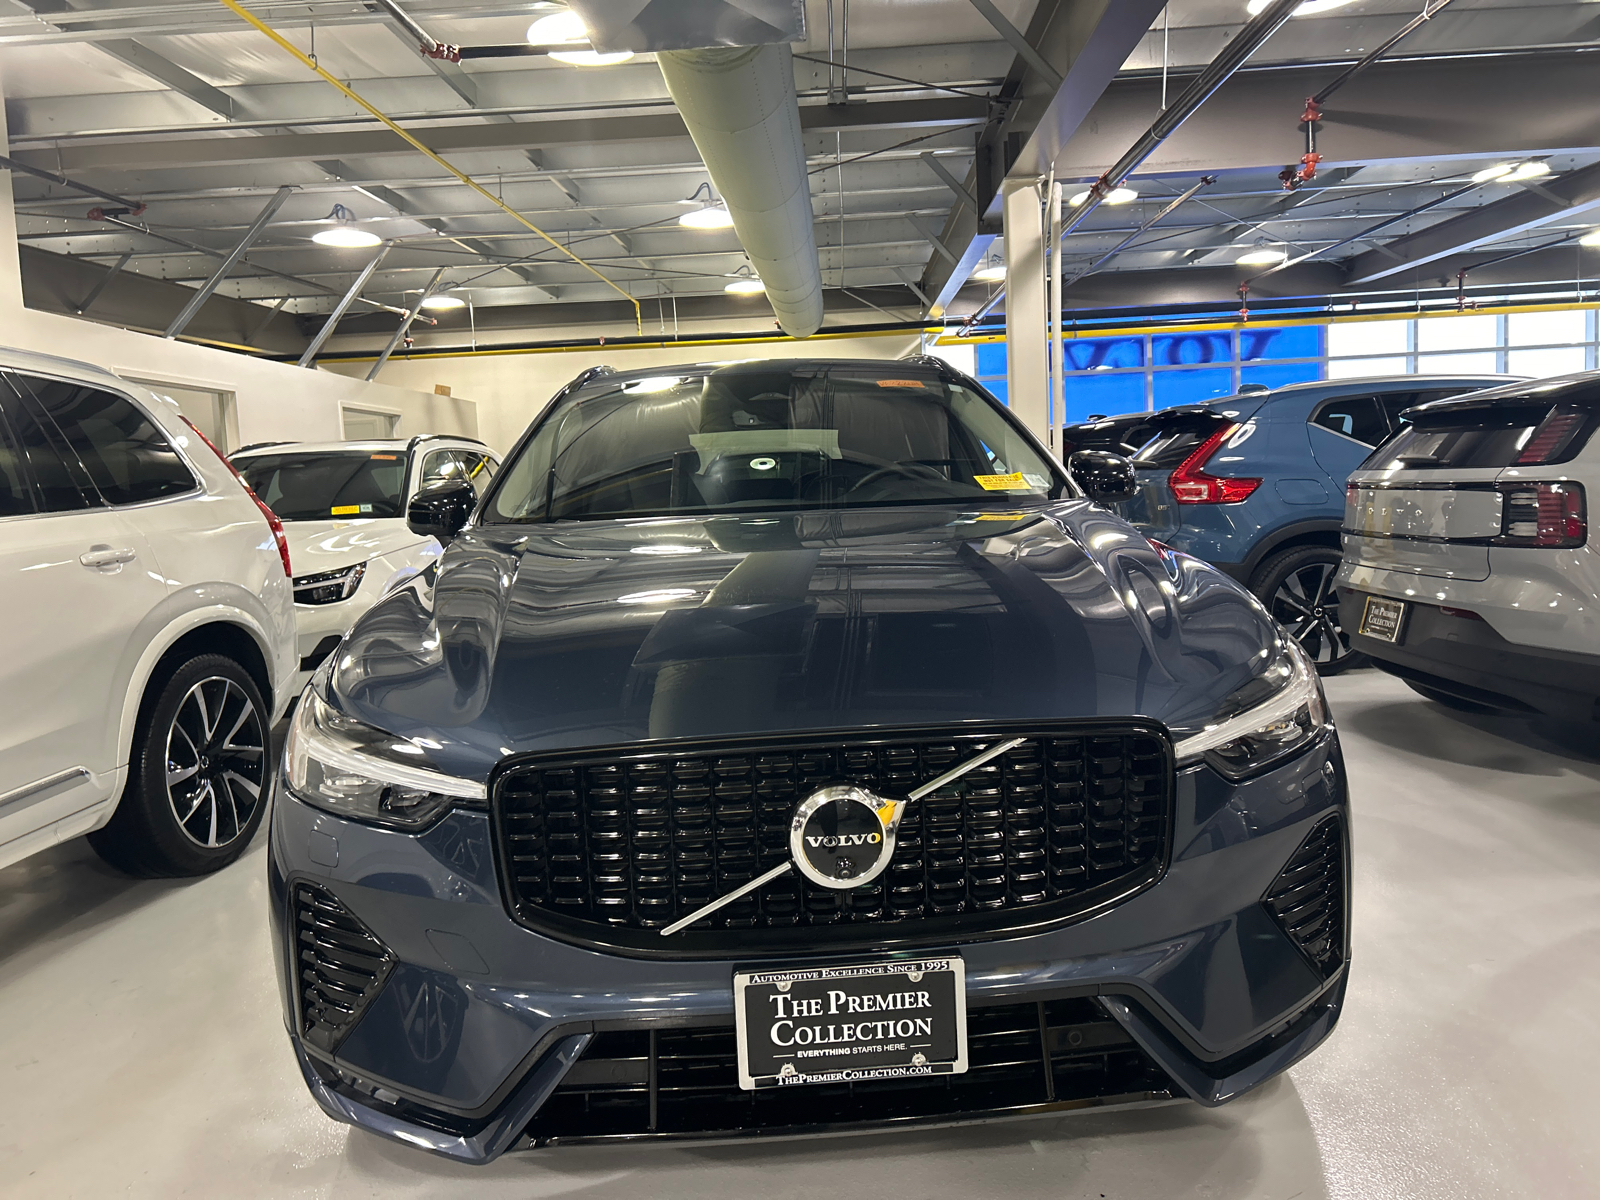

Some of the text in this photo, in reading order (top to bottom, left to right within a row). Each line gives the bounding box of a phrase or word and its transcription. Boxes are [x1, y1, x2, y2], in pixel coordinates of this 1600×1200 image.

[805, 832, 881, 848] VOLVO
[751, 961, 948, 984] AUTOMOTIVE EXCELLENCE SINCE 1995
[769, 990, 932, 1018] THE PREMIER
[770, 1017, 932, 1046] COLLECTION
[797, 1043, 907, 1058] EVERYTHING STARTS HERE.
[775, 1066, 932, 1085] THEPREMIERCOLLECTION.COM
